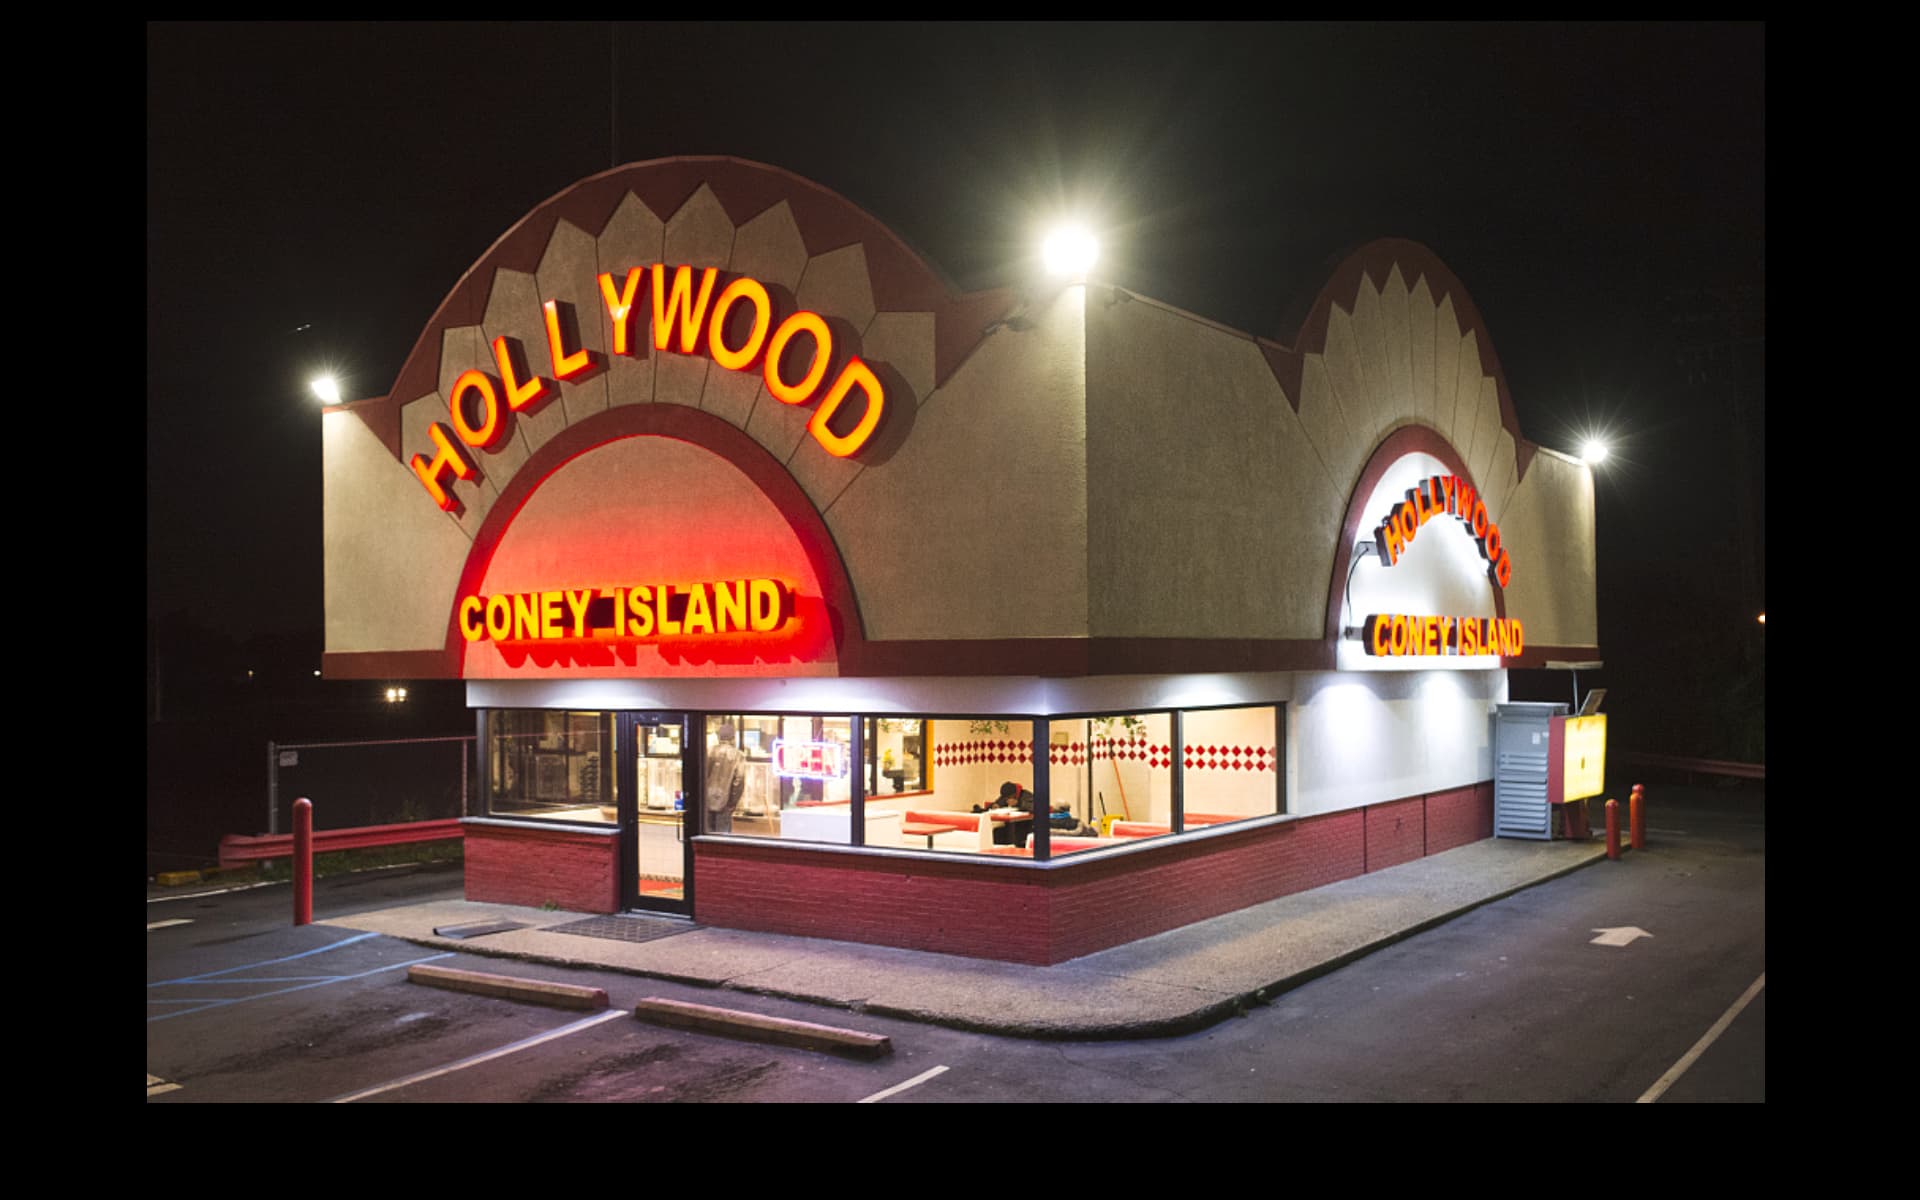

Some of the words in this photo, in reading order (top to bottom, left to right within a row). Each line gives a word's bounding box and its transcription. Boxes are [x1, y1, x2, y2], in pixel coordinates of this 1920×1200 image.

[411, 263, 885, 513] HOLLYWOOD
[1383, 475, 1512, 589] HOLLYWOOD
[459, 588, 593, 643] CONEY
[614, 578, 782, 638] ISLAND
[1373, 613, 1451, 656] CONEY
[1457, 615, 1524, 656] ISLAND
[777, 744, 839, 776] OPEN
